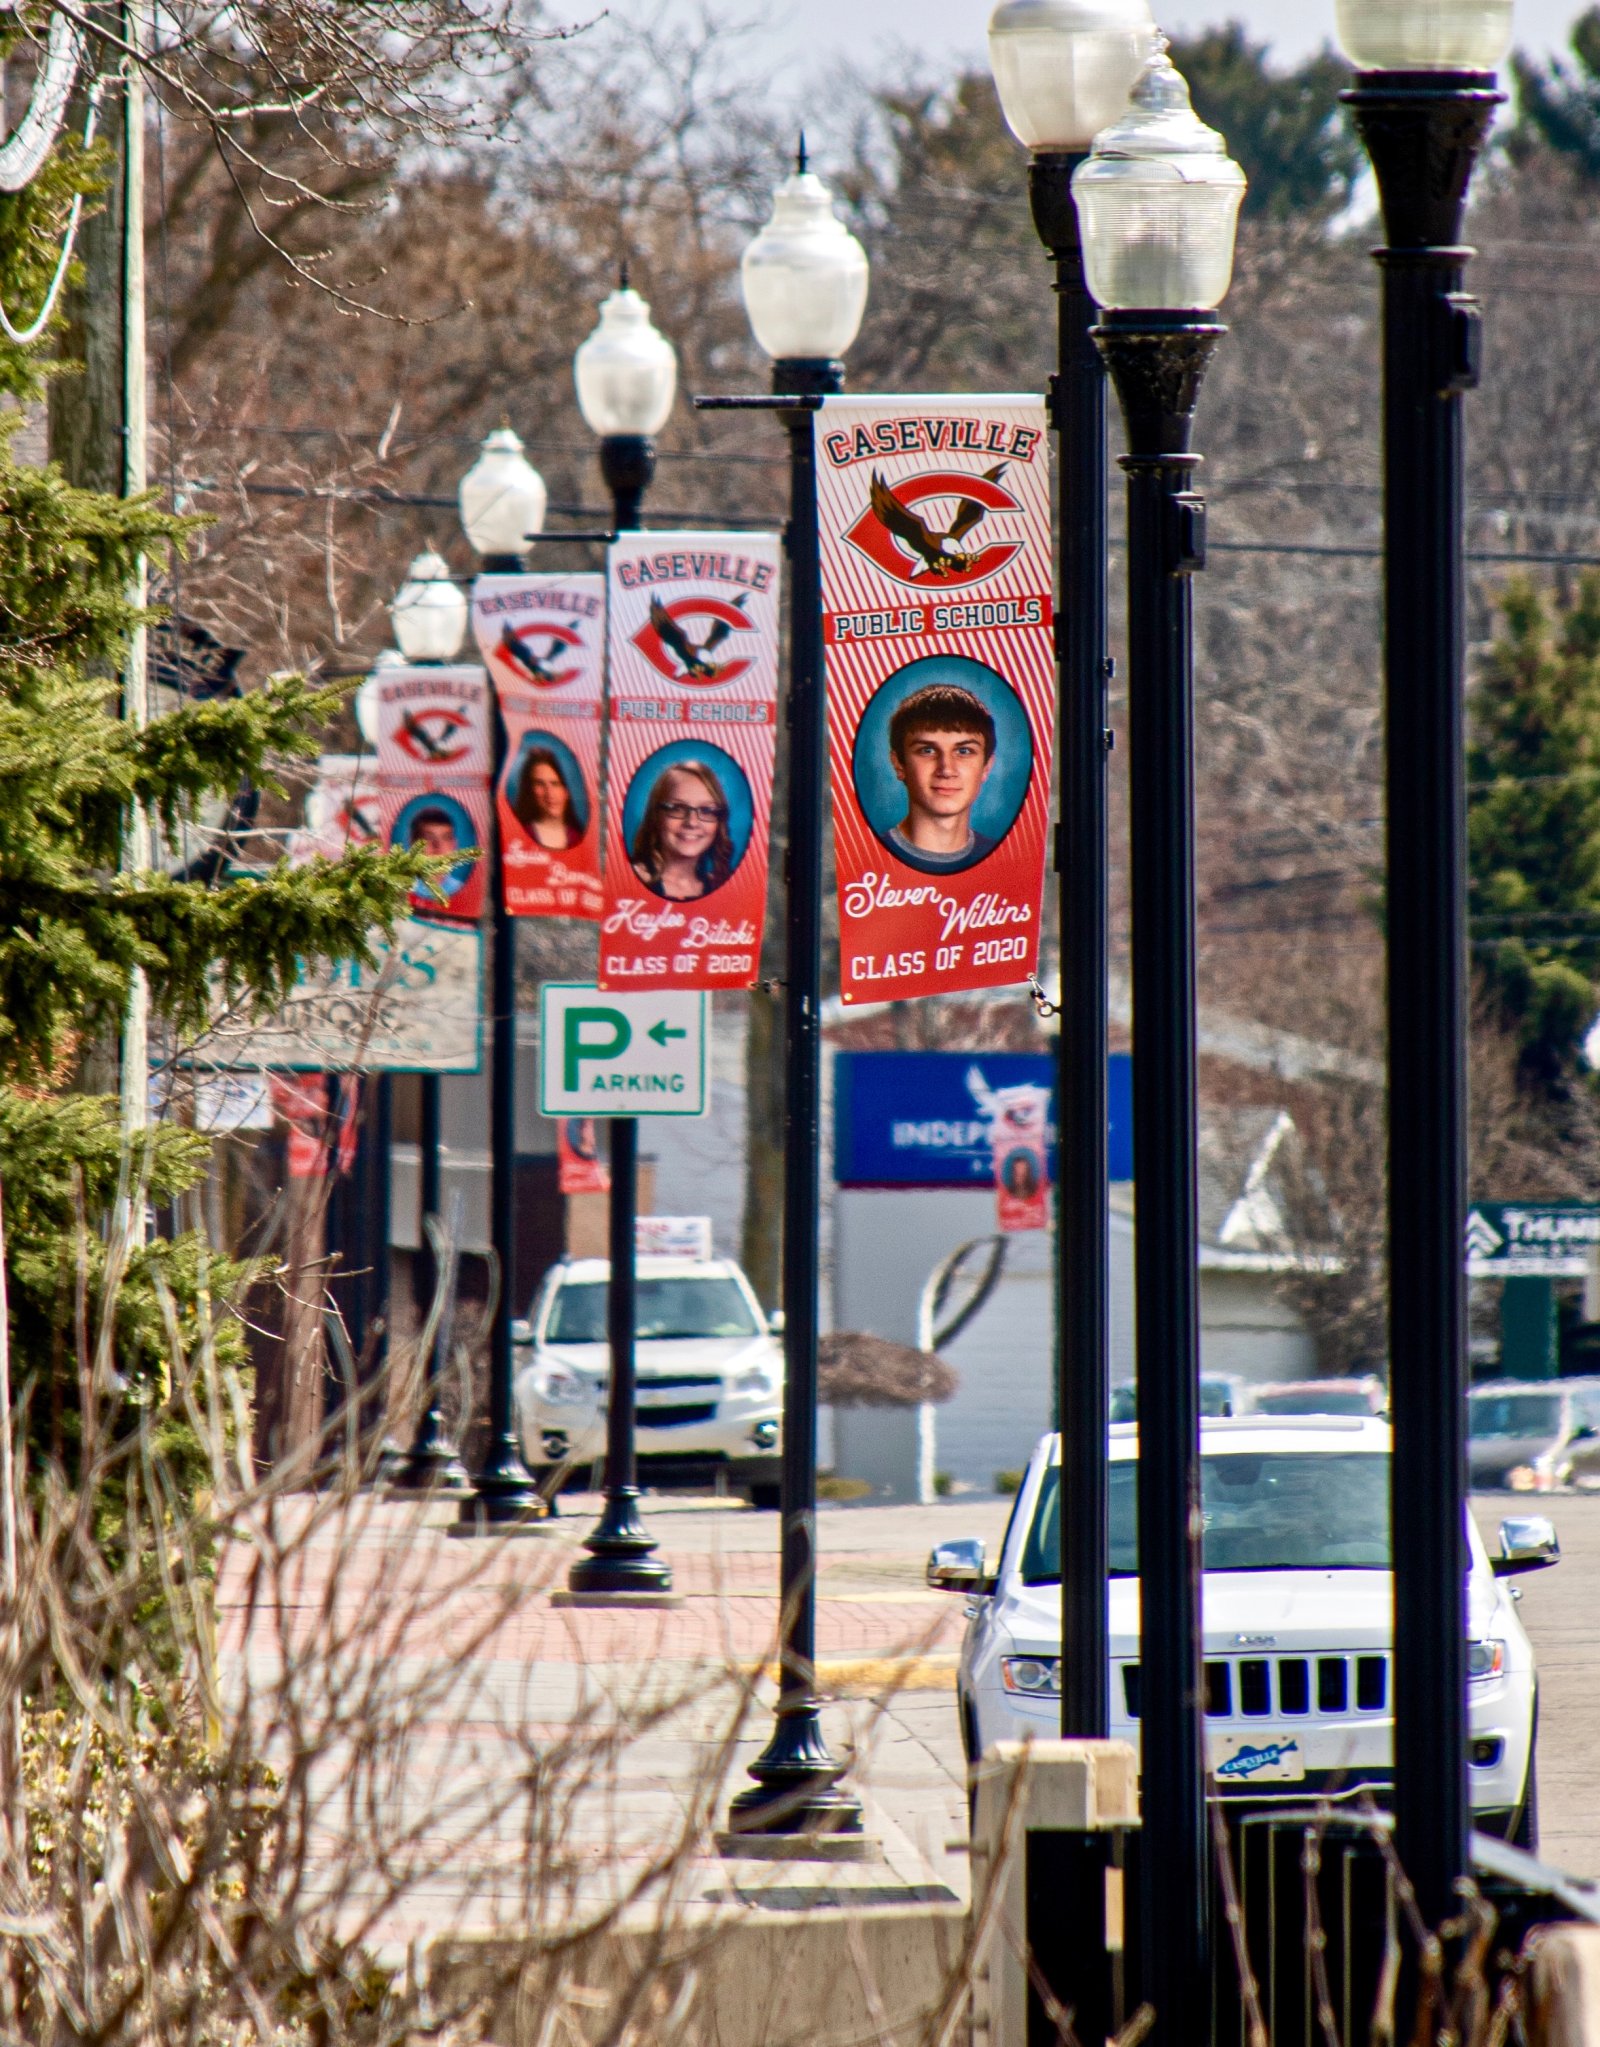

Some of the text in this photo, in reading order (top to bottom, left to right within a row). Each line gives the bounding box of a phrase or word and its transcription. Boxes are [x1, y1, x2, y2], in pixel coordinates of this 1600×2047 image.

[823, 417, 1041, 468] CASEVILLE
[617, 552, 775, 593] CASEVILLE
[479, 590, 600, 617] CASEVILLE
[836, 600, 1041, 639] PUBLIC SCHOOLS
[619, 700, 768, 723] PUBLIC SCHOOLS
[845, 872, 942, 918] Steven
[939, 893, 1032, 941] Wilkins
[606, 954, 752, 975] CLASS OF 2020
[851, 936, 1028, 980] CLASS OF 2020
